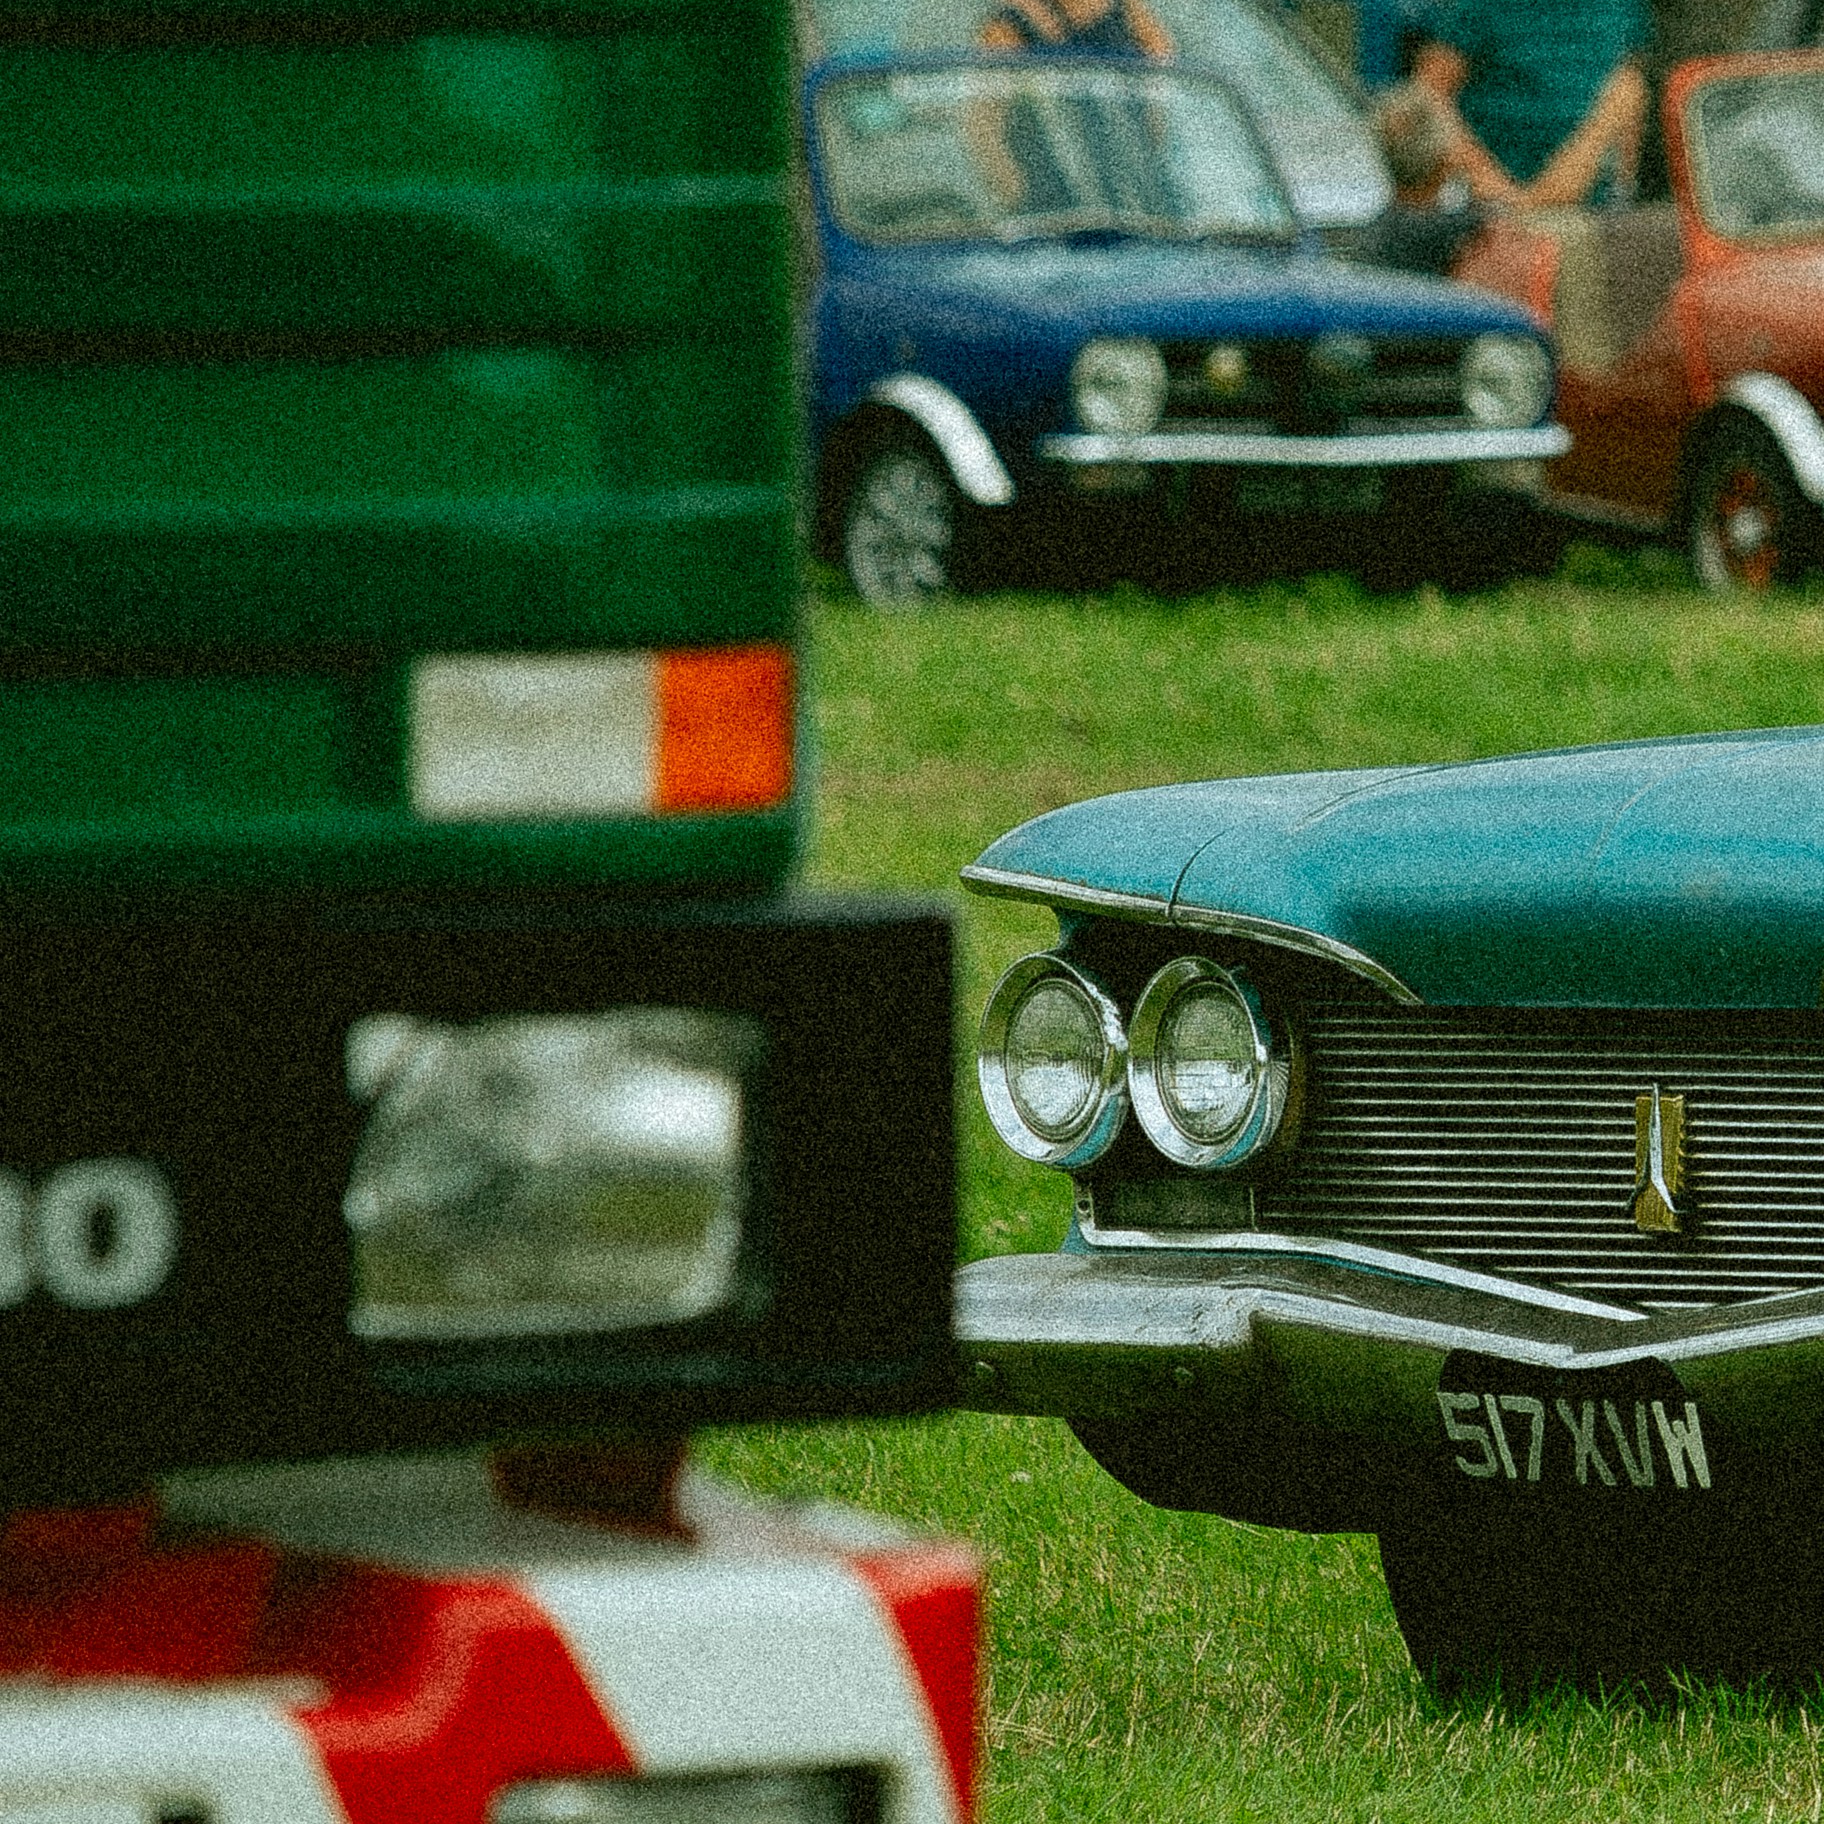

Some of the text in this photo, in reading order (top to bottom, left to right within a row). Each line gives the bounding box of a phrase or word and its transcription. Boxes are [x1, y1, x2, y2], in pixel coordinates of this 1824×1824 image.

[0, 1156, 180, 1311] 0
[1436, 1391, 1711, 1489] 517 XVW
